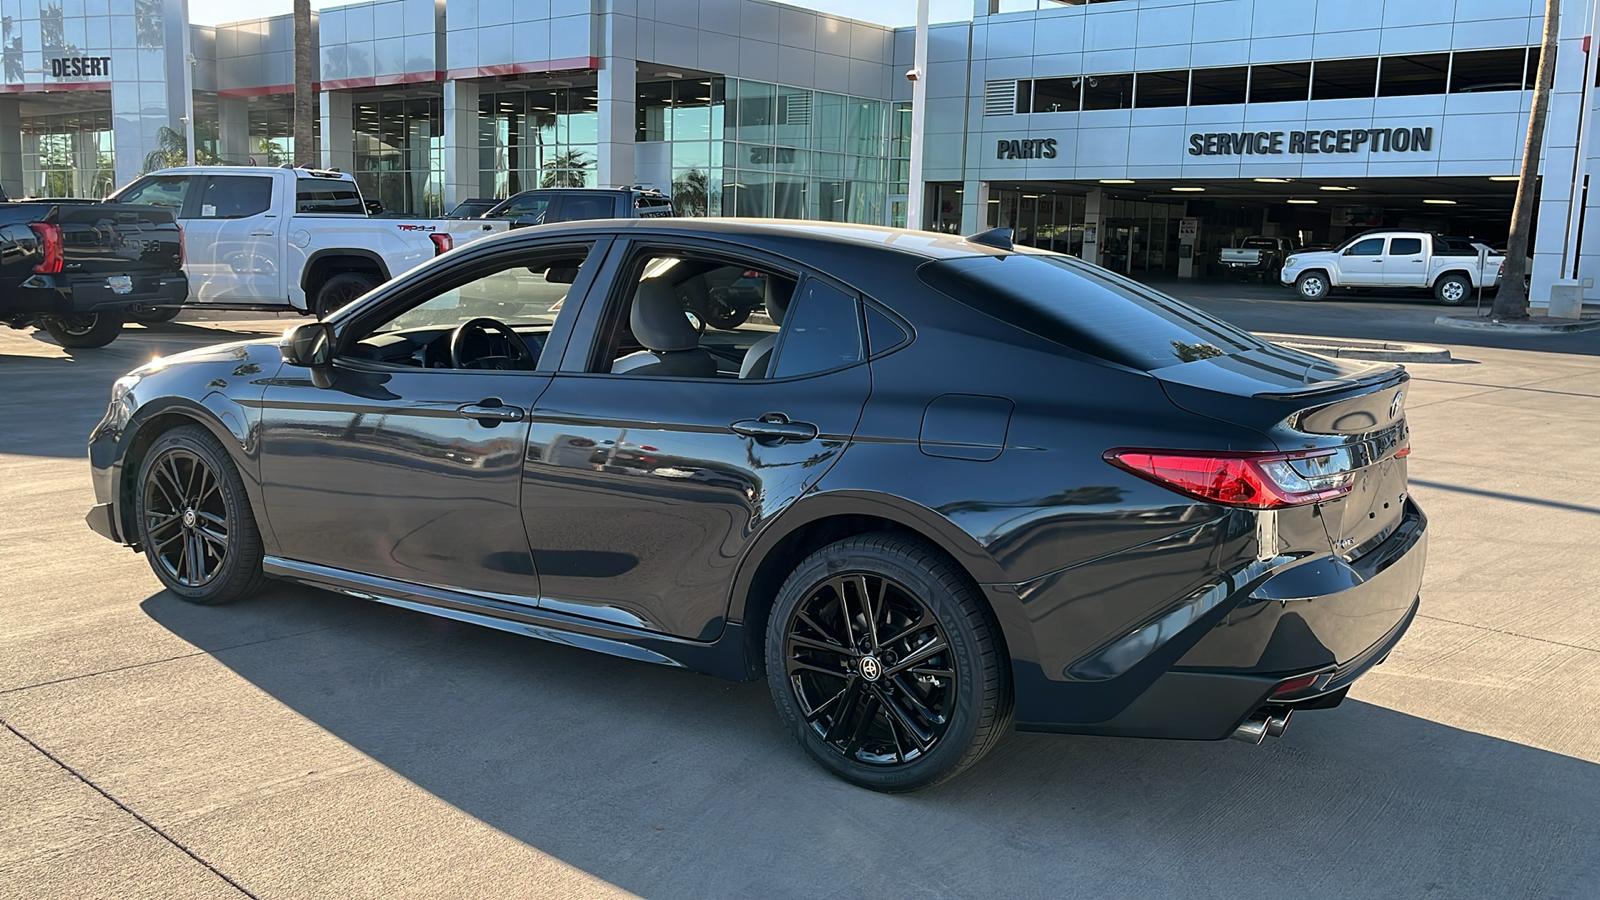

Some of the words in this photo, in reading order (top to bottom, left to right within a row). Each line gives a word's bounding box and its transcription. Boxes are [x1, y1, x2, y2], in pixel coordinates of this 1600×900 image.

[52, 57, 111, 77] DESERT
[997, 138, 1058, 159] PARTS
[1189, 132, 1285, 156] SERVICE
[1289, 127, 1433, 154] RECEPTION
[941, 614, 971, 694] ASSURANCE
[772, 650, 796, 721] GOODYEAR
